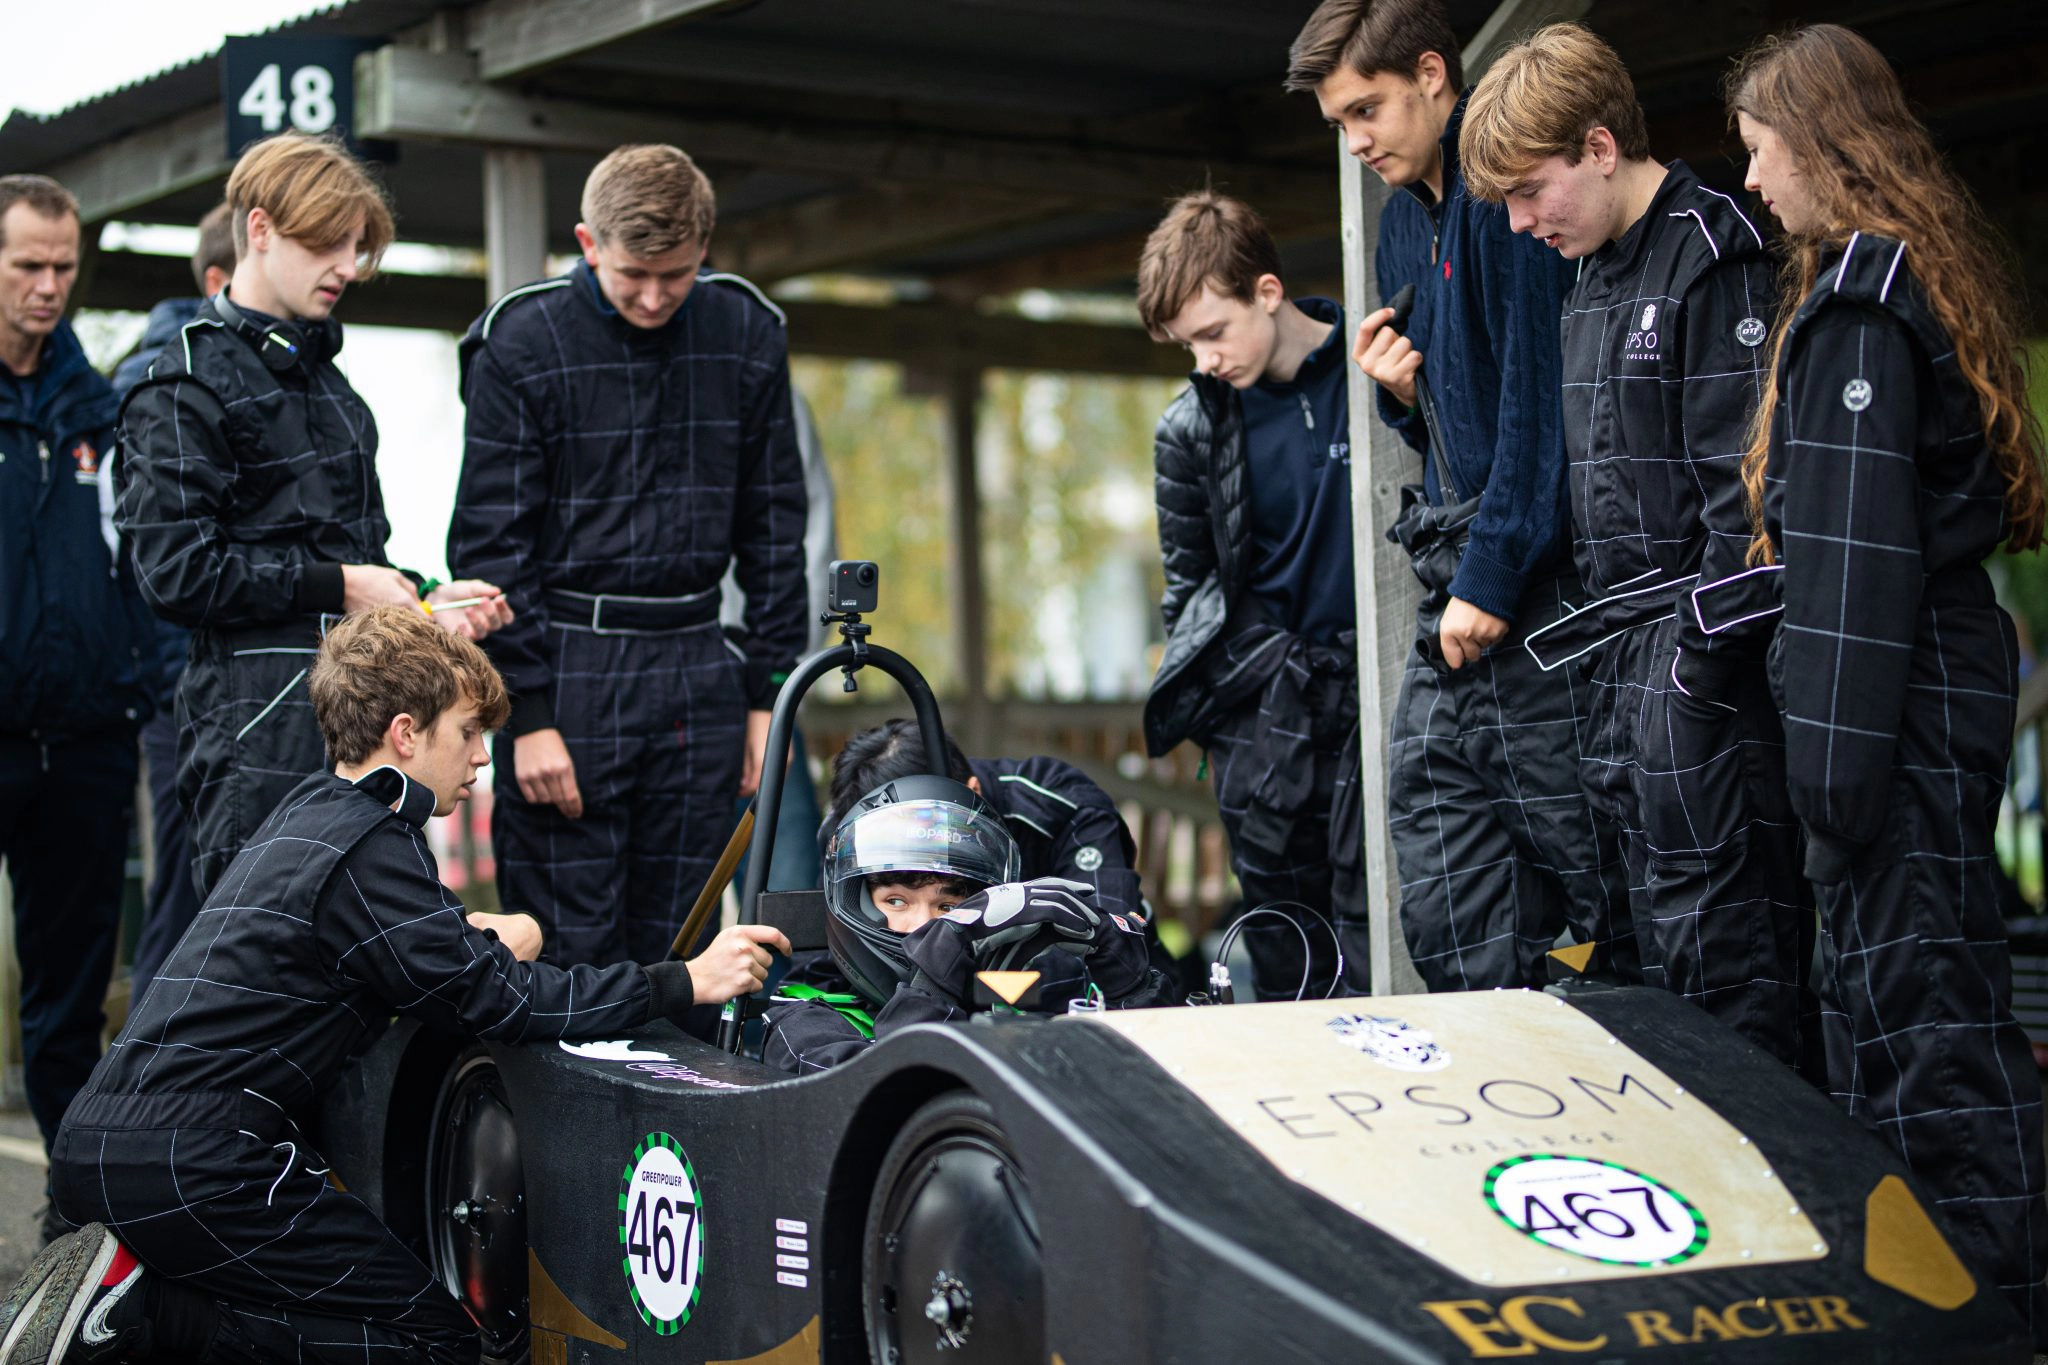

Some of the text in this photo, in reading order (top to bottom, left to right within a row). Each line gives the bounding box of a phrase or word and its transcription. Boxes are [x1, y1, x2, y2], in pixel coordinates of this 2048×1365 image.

[238, 63, 336, 133] 48
[1257, 1072, 1674, 1139] EPSOM
[1419, 1131, 1624, 1158] COLLEGE
[641, 1170, 682, 1187] GREENPOWER
[629, 1191, 695, 1285] 467
[1522, 1187, 1673, 1239] 467
[1422, 1296, 1869, 1357] EC RACER
